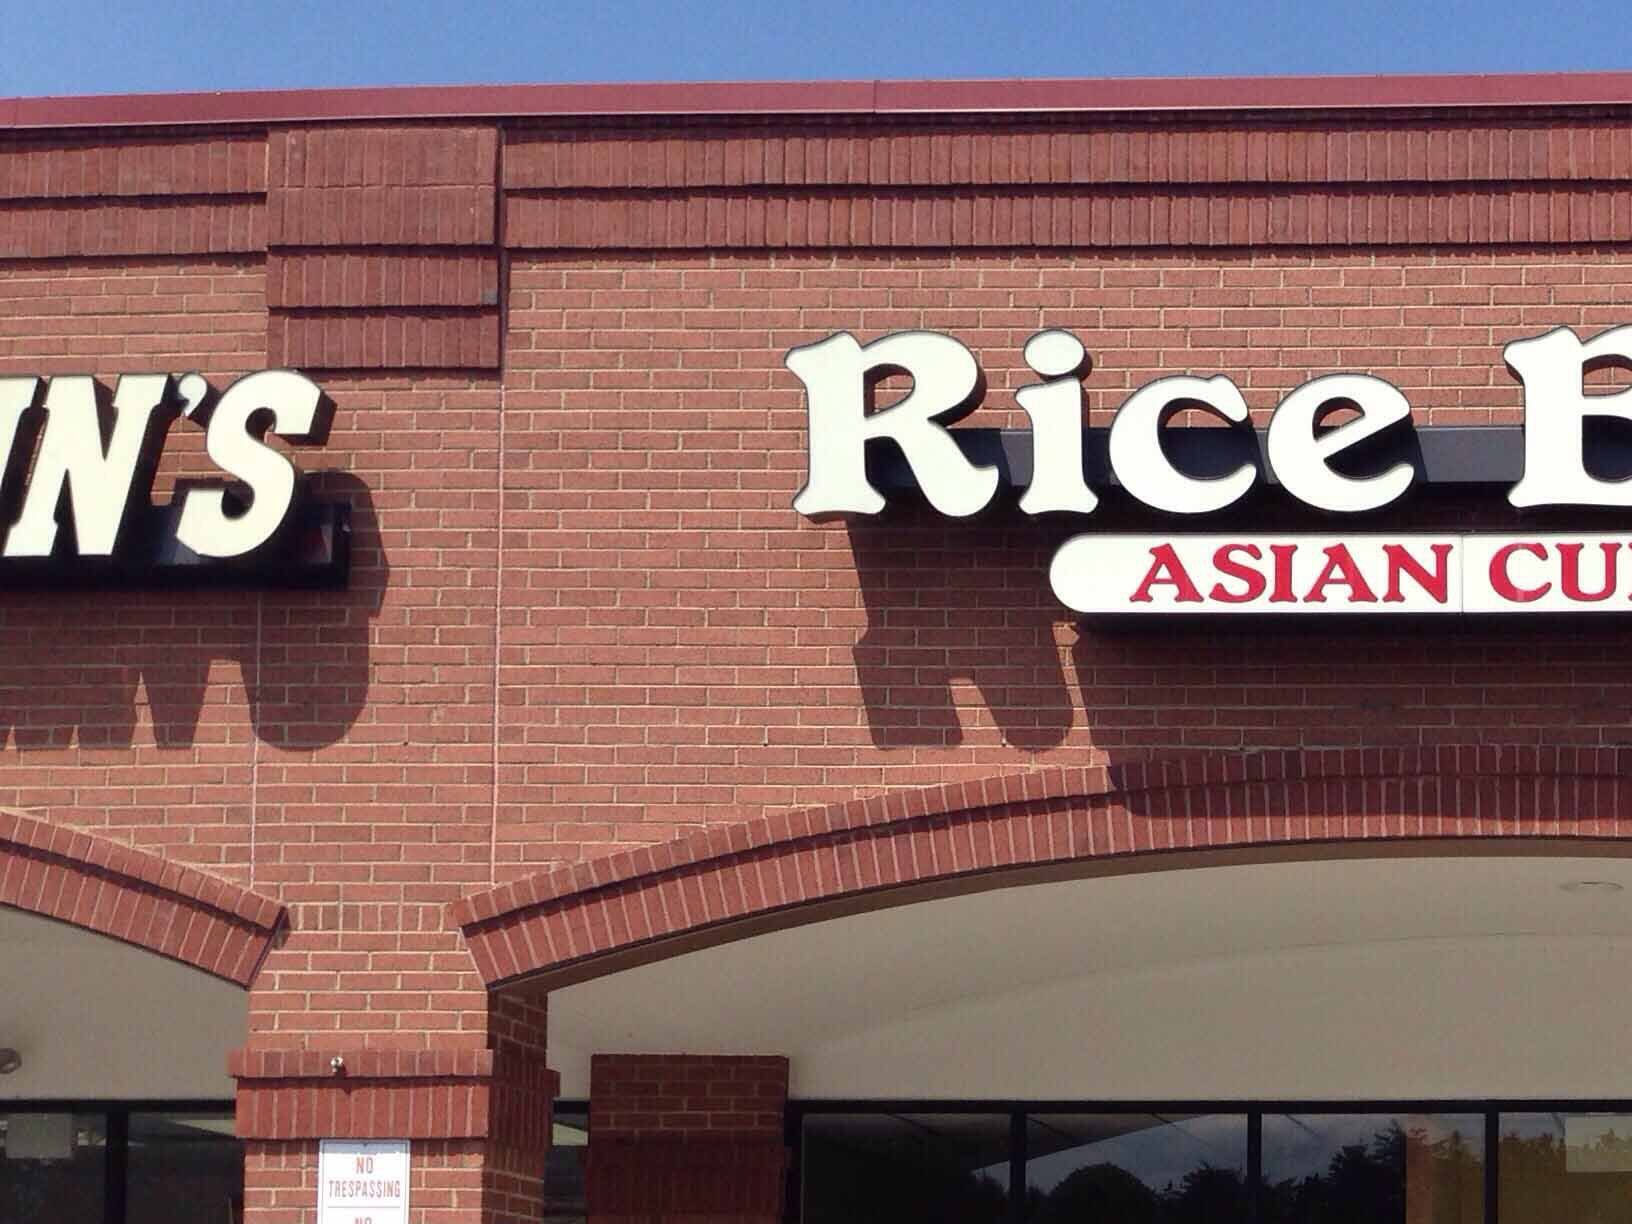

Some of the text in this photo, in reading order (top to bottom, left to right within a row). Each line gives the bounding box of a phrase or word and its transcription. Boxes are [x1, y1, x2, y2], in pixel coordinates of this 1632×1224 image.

[785, 329, 1416, 518] Rice
[0, 368, 322, 558] N'S
[1129, 542, 1455, 604] ASIAN
[328, 1180, 401, 1199] TRESPASSING
[355, 1157, 374, 1174] NO
